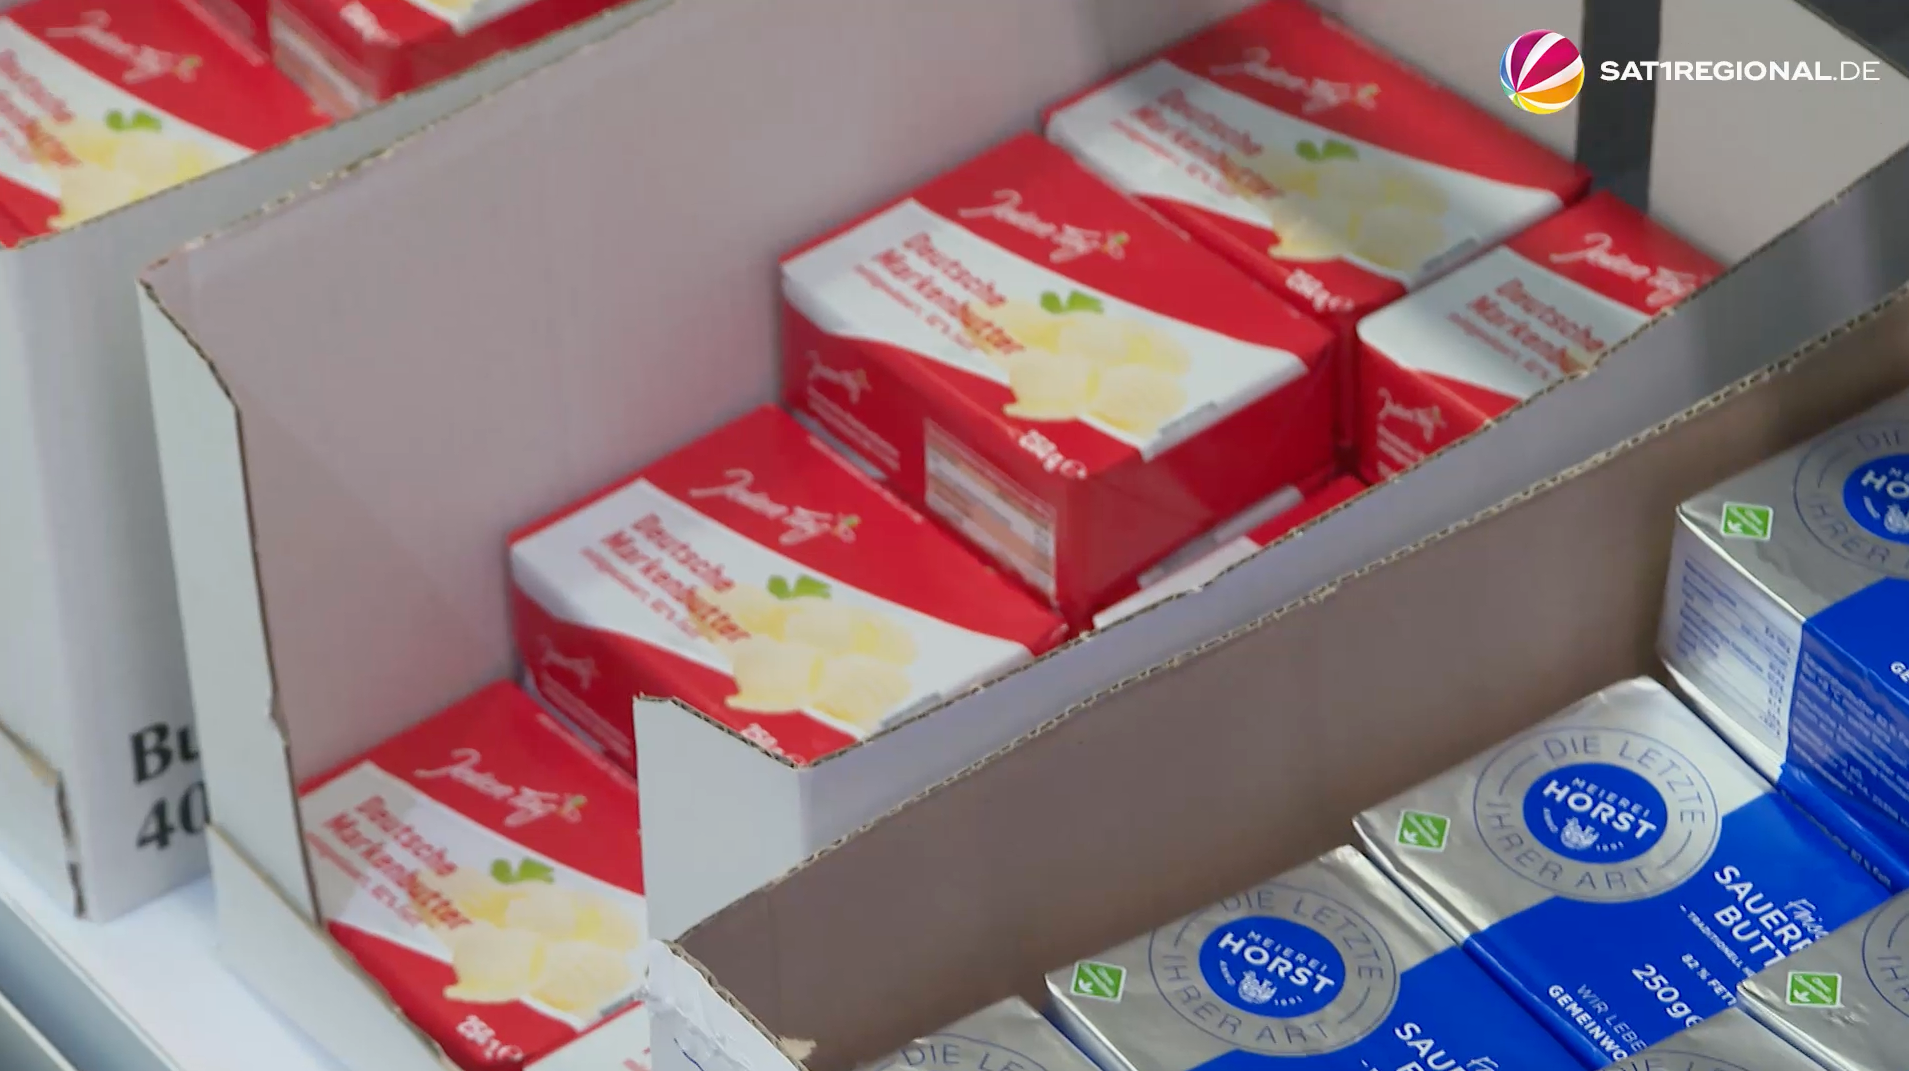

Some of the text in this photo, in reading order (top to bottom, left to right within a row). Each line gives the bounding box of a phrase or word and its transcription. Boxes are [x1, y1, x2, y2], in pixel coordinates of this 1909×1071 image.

[902, 232, 1008, 308] Deutsche
[600, 529, 751, 643] Markenbutter
[631, 512, 736, 594] Deutsche
[136, 780, 210, 849] 40
[1542, 779, 1658, 839] HORST
[1543, 736, 1602, 760] DIE
[1619, 740, 1706, 824] LETZTE
[322, 811, 474, 930] Markenbutter
[354, 795, 459, 876] Deutsche
[1486, 801, 1563, 881] IHRER
[1576, 867, 1649, 891] ART
[1218, 931, 1335, 994] HORST
[1293, 897, 1384, 981] LETZTE
[1163, 954, 1242, 1035] IHRER
[1256, 1021, 1329, 1044] ART
[1548, 984, 1629, 1061] GEMEINWO
[1577, 984, 1648, 1053] WIR LEBE
[901, 1044, 960, 1066] DIE
